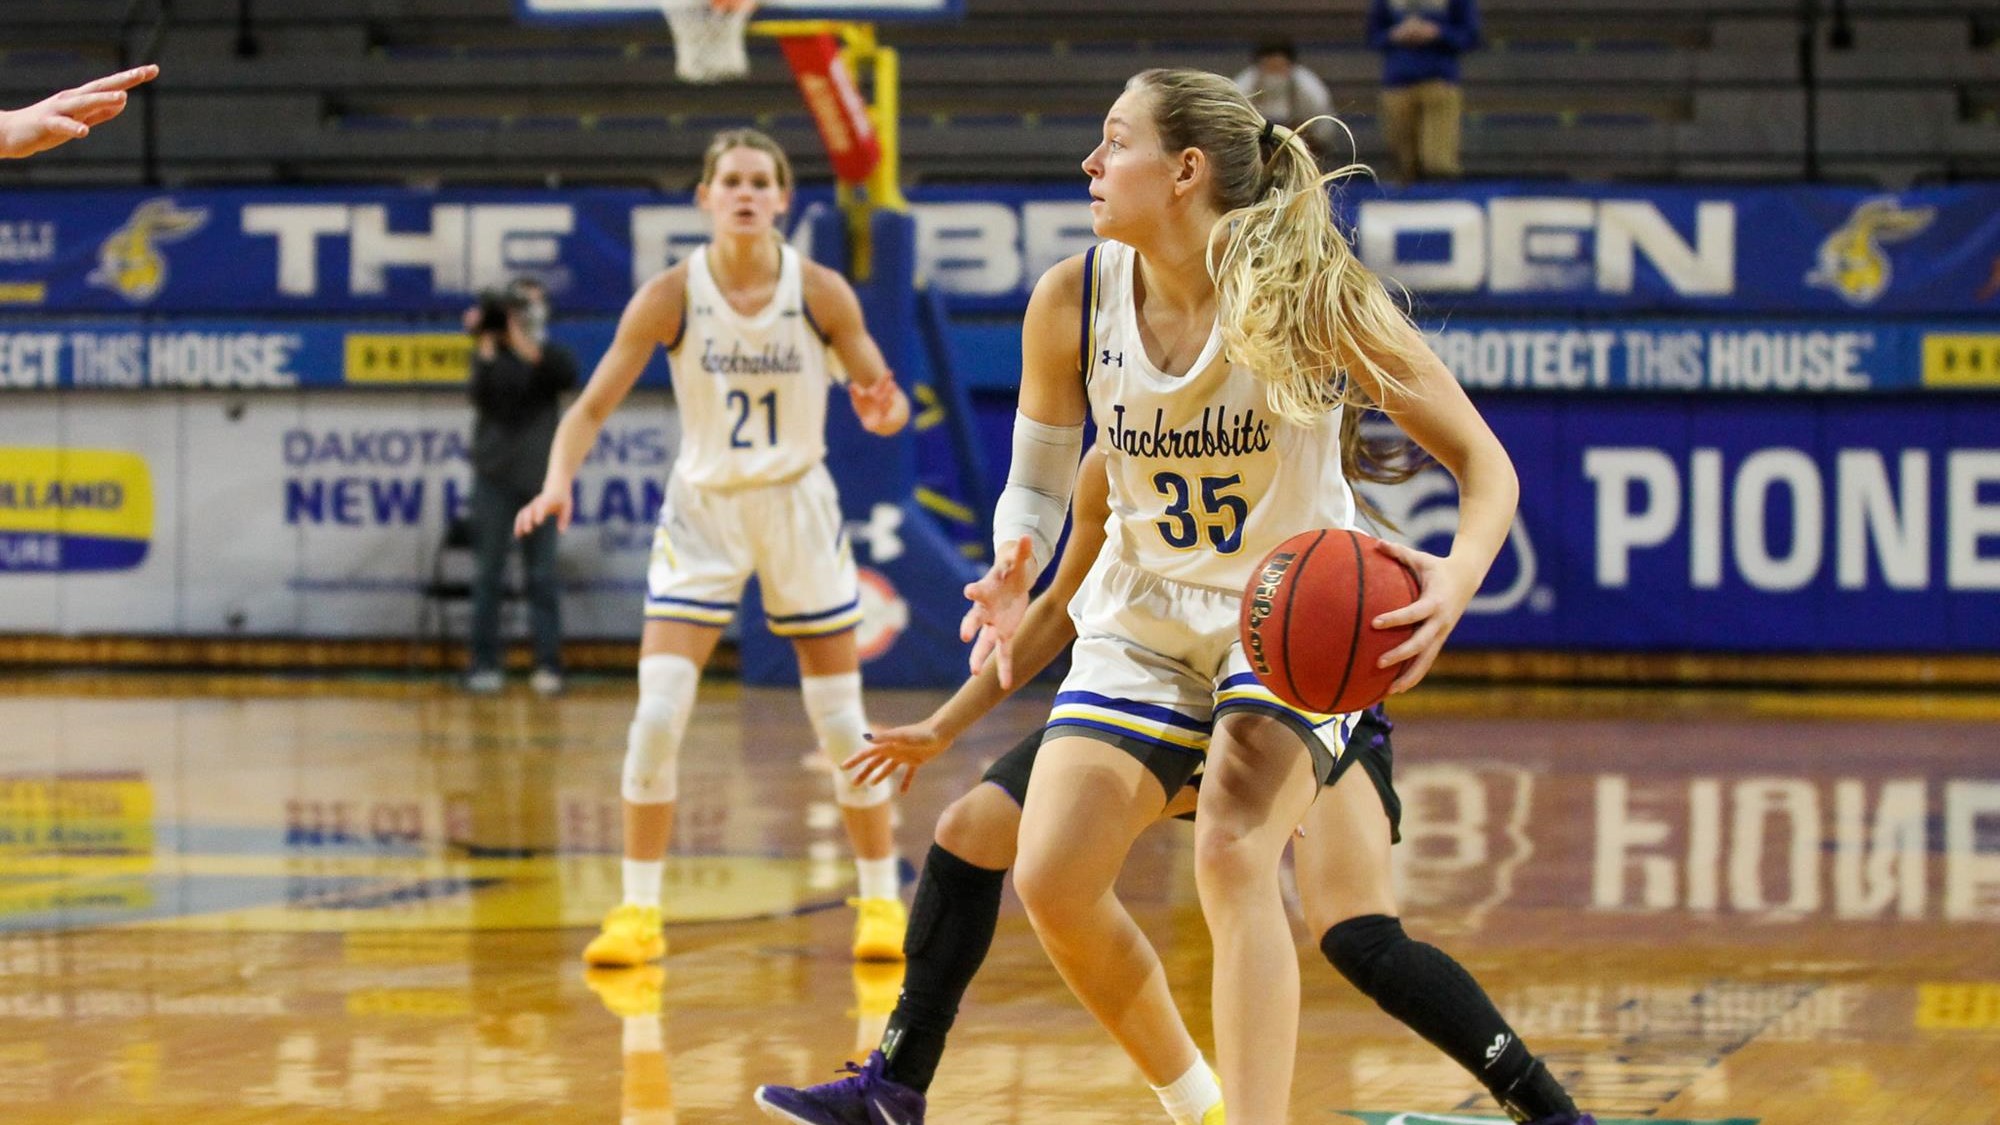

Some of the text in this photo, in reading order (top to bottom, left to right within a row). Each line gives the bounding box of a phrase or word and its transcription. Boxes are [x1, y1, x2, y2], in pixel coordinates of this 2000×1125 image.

[240, 203, 575, 294] THE
[1359, 198, 1736, 298] DEN
[1623, 331, 1703, 387] THIS
[284, 428, 472, 467] DAKOTA
[726, 387, 778, 449] 21
[1108, 404, 1272, 458] Jackrabbits
[286, 475, 426, 525] NEW
[1152, 471, 1249, 554] 35
[1583, 447, 2000, 590] PIONE
